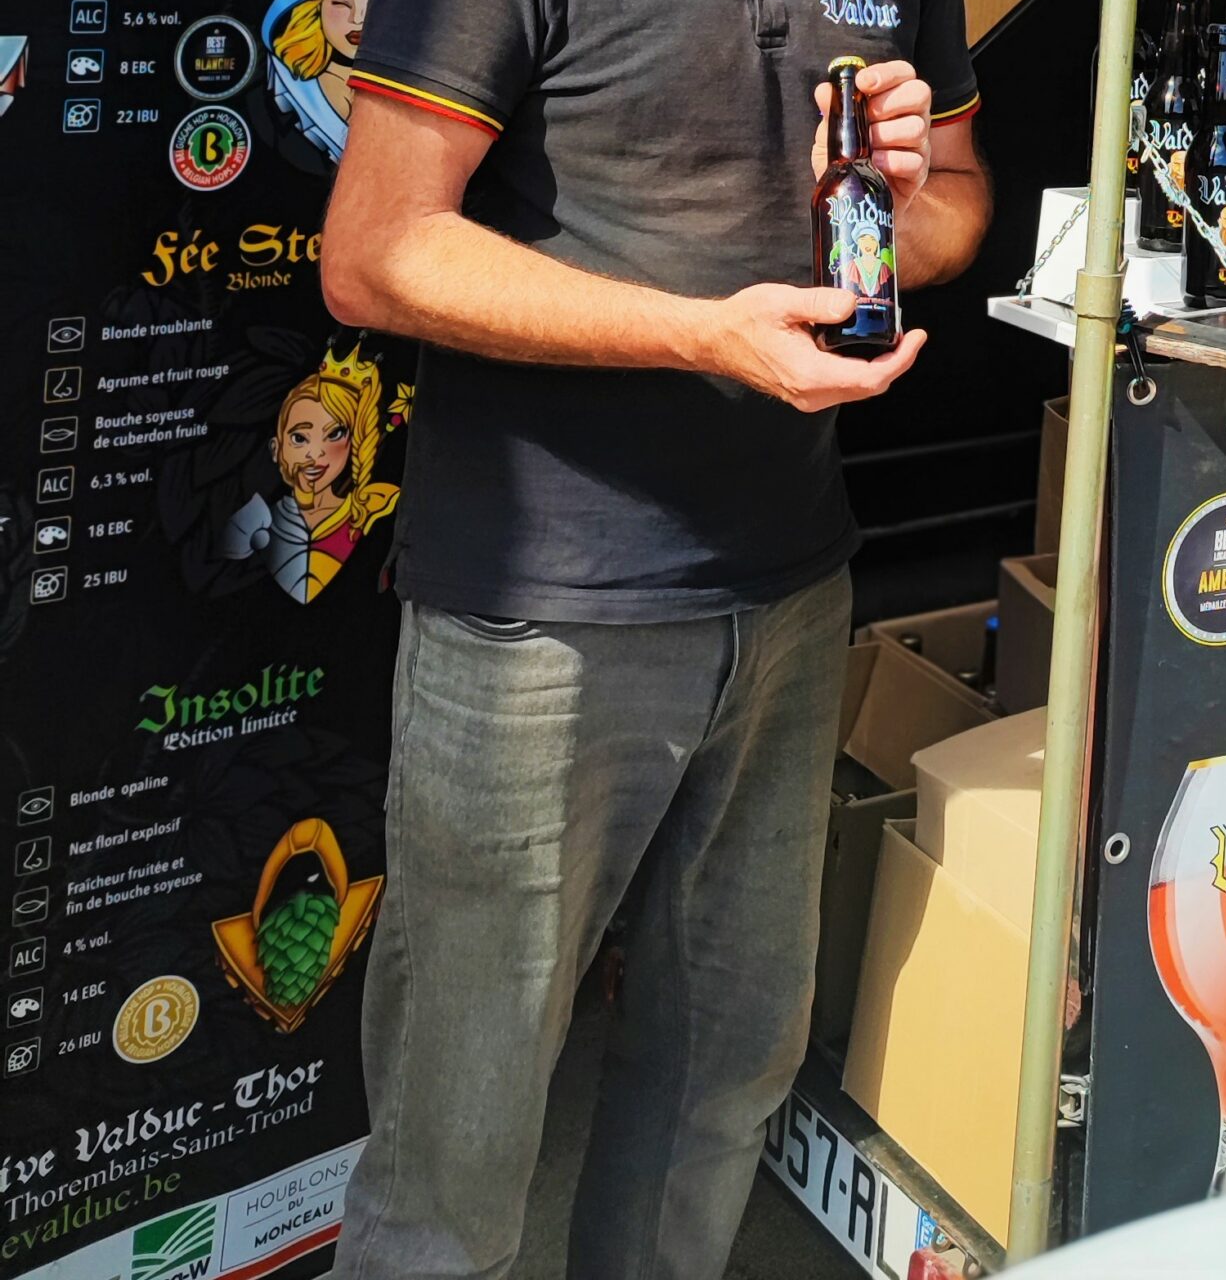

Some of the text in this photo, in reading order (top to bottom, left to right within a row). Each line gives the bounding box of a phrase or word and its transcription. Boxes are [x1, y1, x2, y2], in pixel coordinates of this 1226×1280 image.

[76, 9, 181, 27] ALC 5,6 % vol.
[120, 60, 155, 74] 8 EBC
[116, 108, 159, 123] 22 IBU
[1149, 120, 1194, 150] Vald
[825, 192, 893, 228] Valduc
[141, 224, 322, 287] Fée Ste
[226, 271, 292, 291] Blonde
[102, 317, 213, 341] Blonde troublante
[97, 363, 230, 393] Agrume et fruit rouge
[95, 406, 195, 430] Bouche soyeuse
[94, 422, 208, 450] de cuberdon fruité
[42, 469, 153, 493] ALC 6,3 % vol.
[88, 520, 133, 538] 18 EBC
[83, 569, 128, 588] 25 IBU
[134, 663, 326, 733] Insolite
[162, 706, 297, 751] Edition limitée
[70, 774, 168, 807] Blonde opaline
[69, 817, 182, 856] Nez floral explosif
[67, 856, 185, 896] Fraîcheur fruitée et
[66, 872, 203, 915] fin de bouche soyeuse
[15, 931, 112, 967] ALC 4 % vol.
[62, 980, 107, 1006] 14 EBC
[58, 1031, 102, 1055] 26 IBU
[75, 1101, 203, 1163] Valduc
[234, 1058, 324, 1109] Thor
[4, 1091, 313, 1221] Thorembais-Saint-Trond
[247, 1159, 349, 1217] HOUBLONS
[288, 1196, 304, 1212] DU
[254, 1201, 334, 1248] MONCEAU
